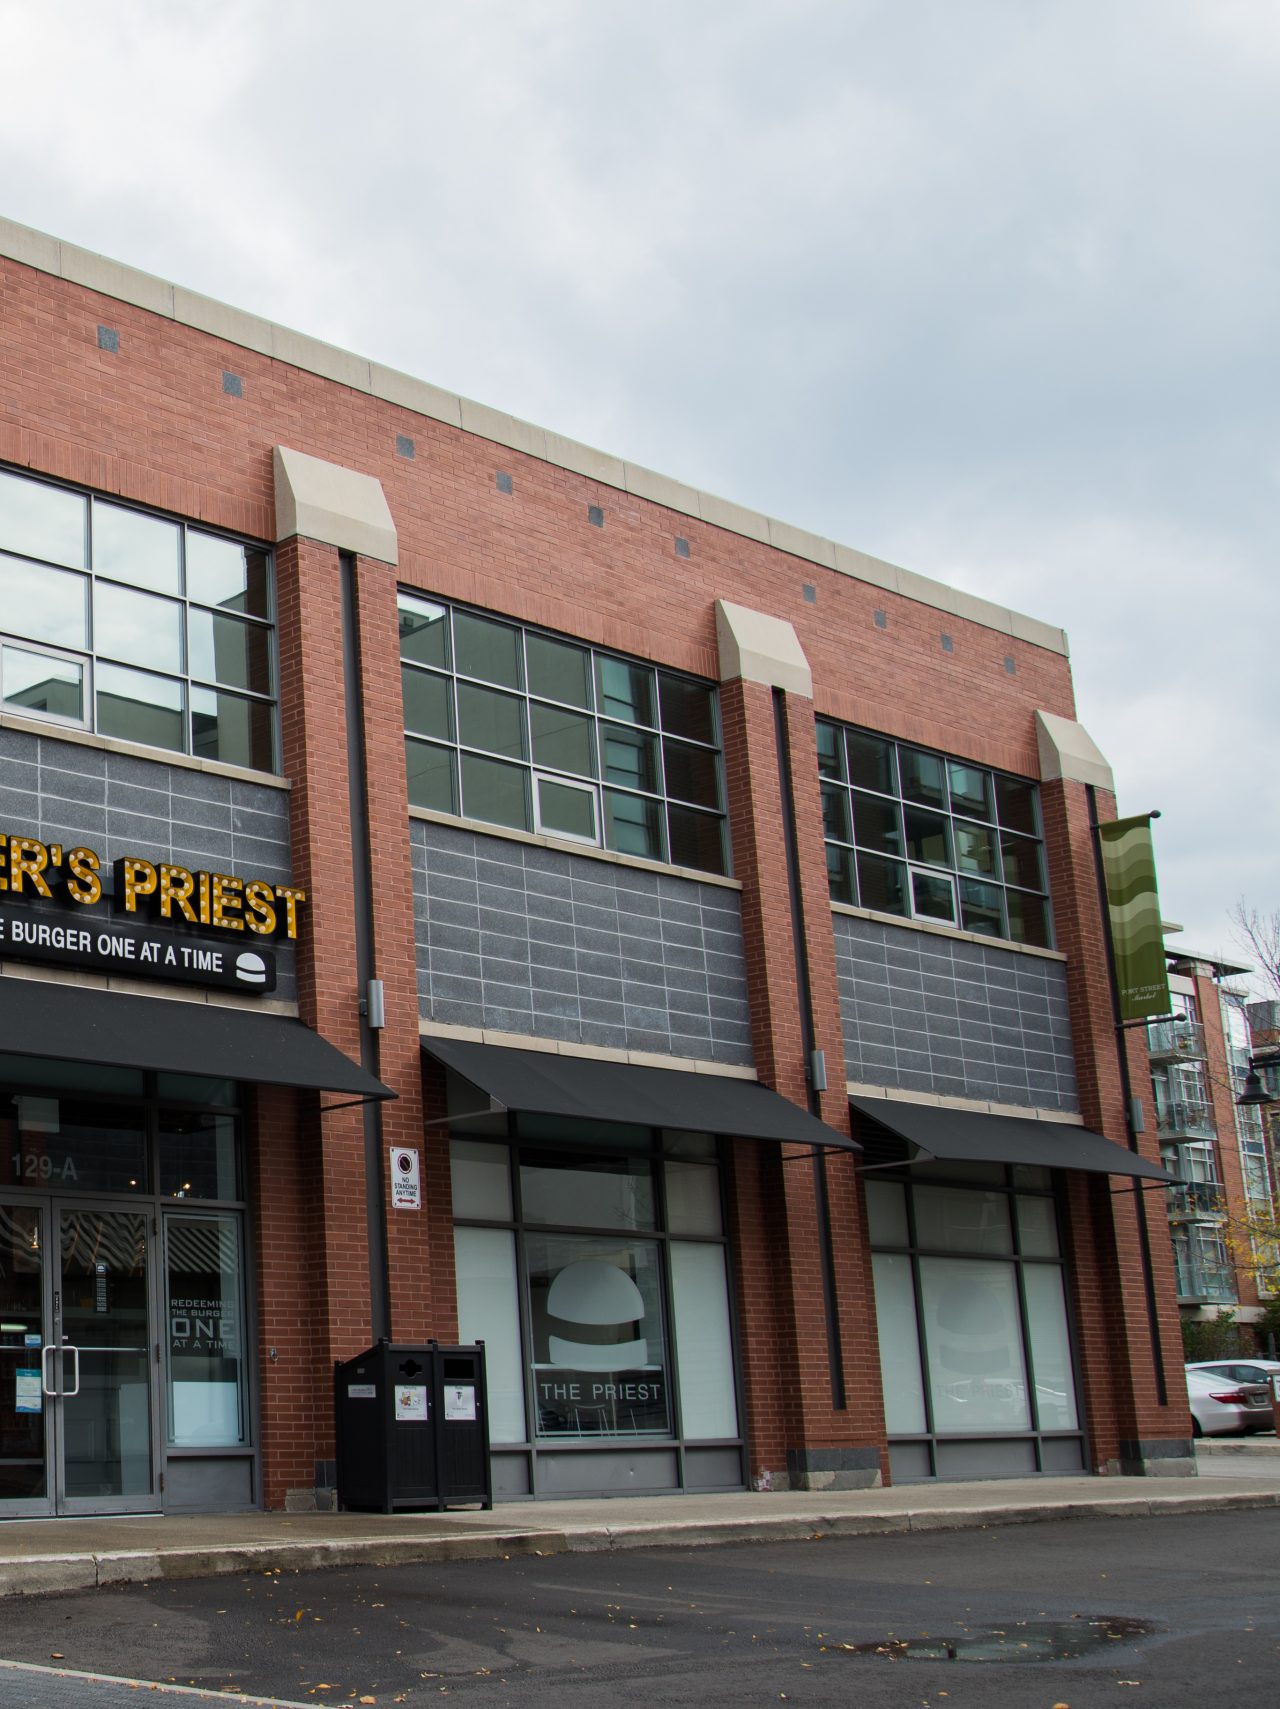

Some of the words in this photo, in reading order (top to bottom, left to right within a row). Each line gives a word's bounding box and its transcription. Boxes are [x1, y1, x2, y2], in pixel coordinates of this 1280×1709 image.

[122, 857, 306, 939] PRIEST
[11, 921, 92, 953] BURGER
[97, 934, 135, 960] ONE
[140, 942, 163, 964] AT
[165, 946, 178, 966] A
[181, 947, 223, 973] TIME
[11, 1153, 78, 1181] 129-A
[171, 1308, 188, 1316] THE
[171, 1317, 234, 1339] ONE
[173, 1339, 188, 1348] AT
[193, 1340, 201, 1349] A
[541, 1383, 581, 1400] THE
[592, 1383, 661, 1400] PRIEST
